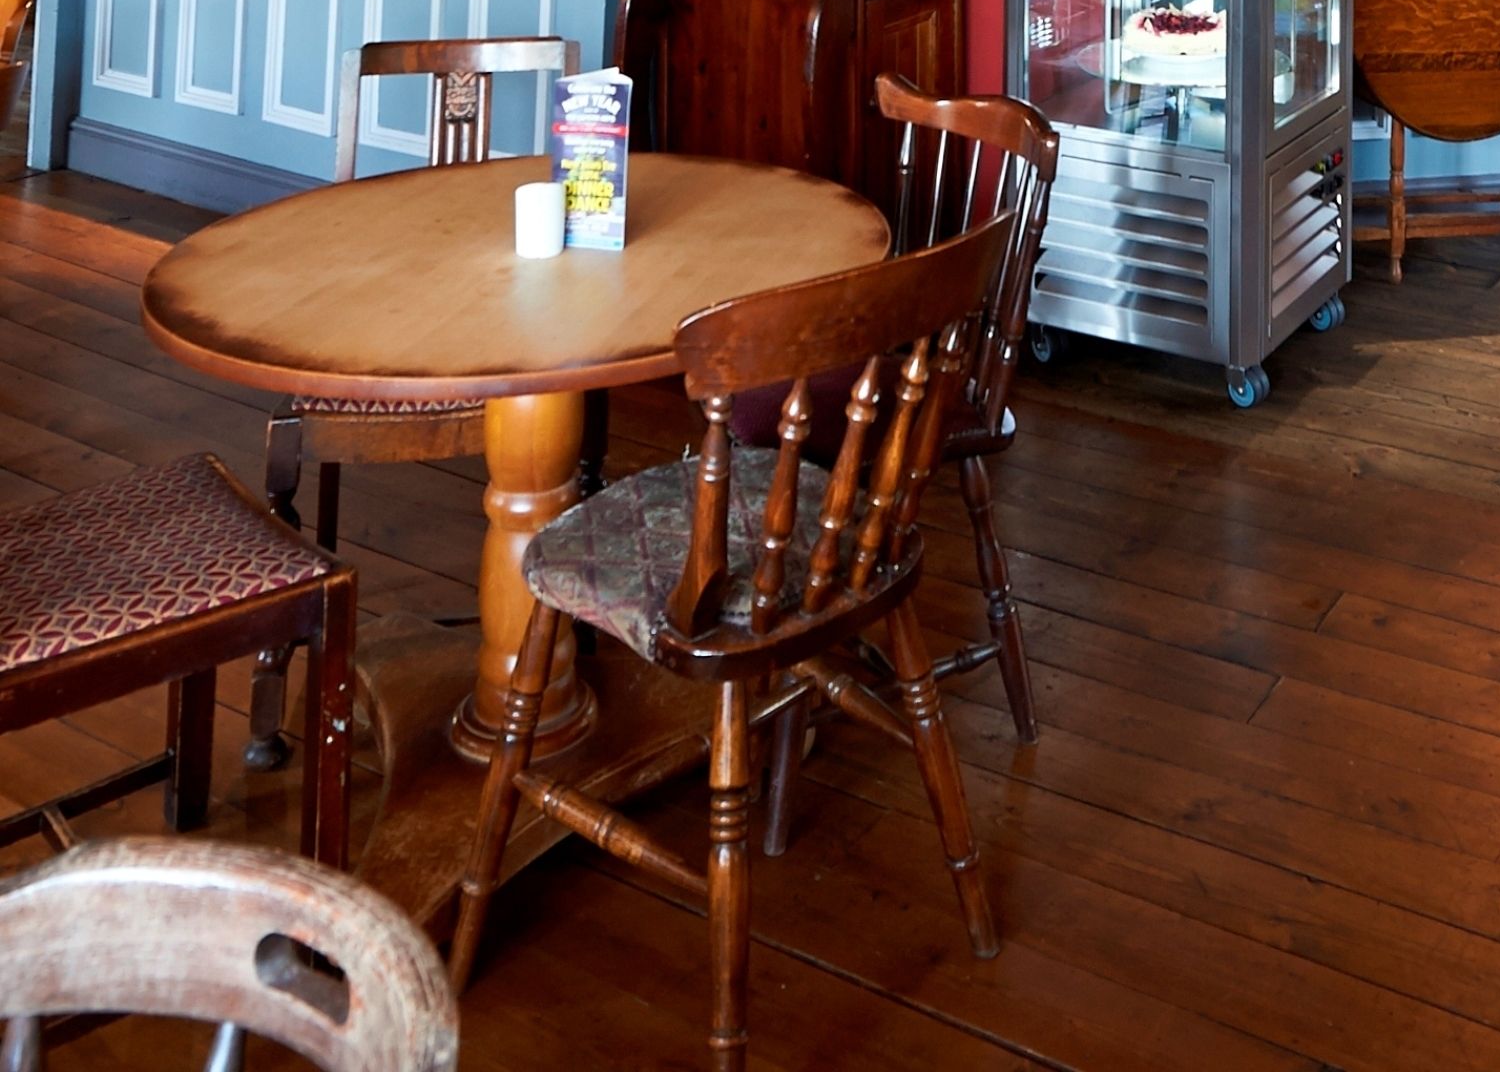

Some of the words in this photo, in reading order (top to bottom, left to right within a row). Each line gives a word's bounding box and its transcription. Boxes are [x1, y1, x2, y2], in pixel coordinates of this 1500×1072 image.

[561, 95, 590, 114] NEW
[591, 95, 622, 116] YEAR
[563, 180, 615, 198] DINNER
